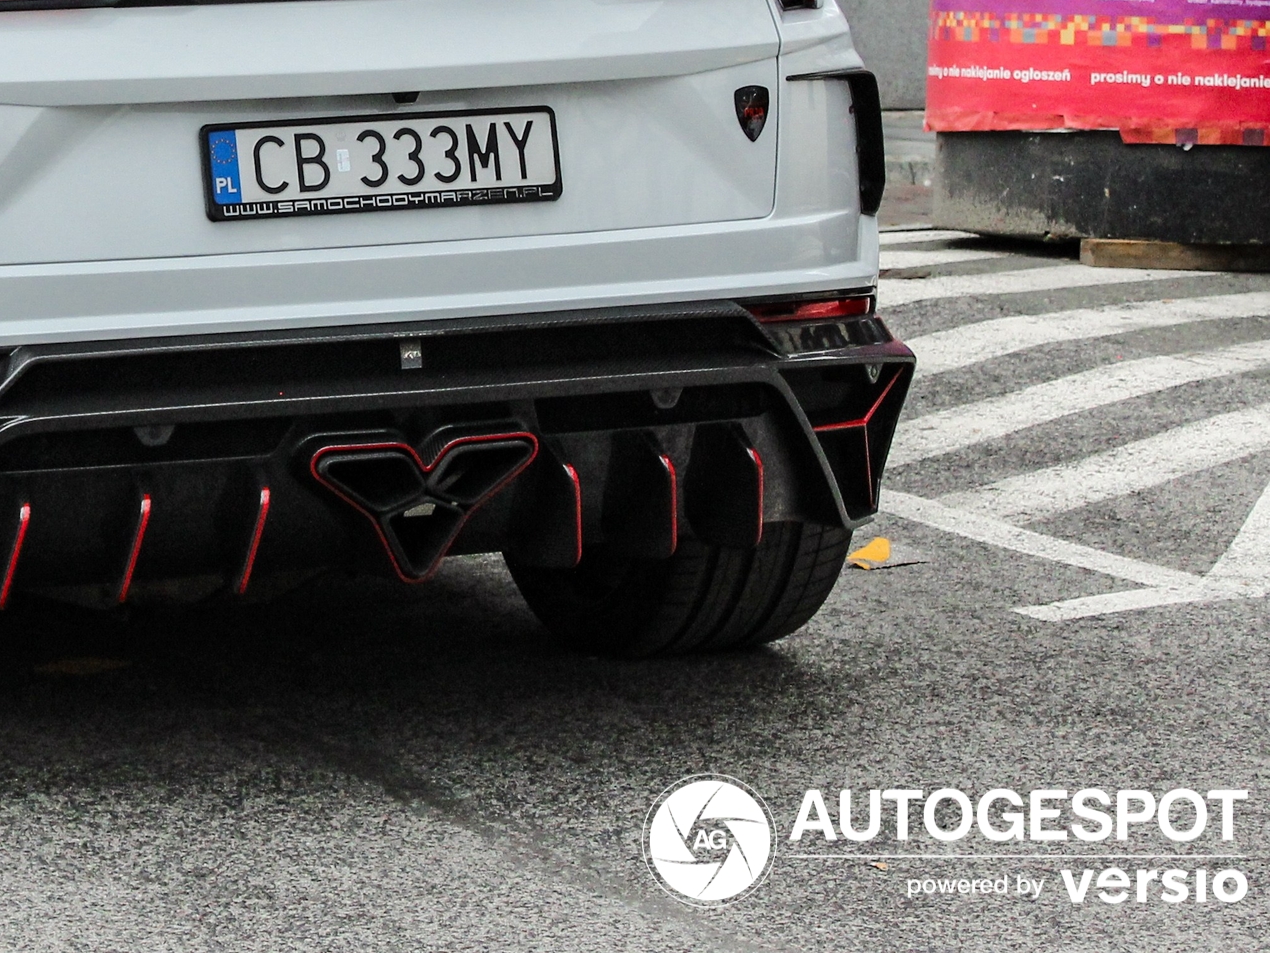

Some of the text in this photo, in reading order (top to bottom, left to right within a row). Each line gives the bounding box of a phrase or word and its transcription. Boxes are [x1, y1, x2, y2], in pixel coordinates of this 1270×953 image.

[961, 65, 1011, 81] naklejanie
[1013, 67, 1071, 83] ogłoszeń
[1090, 70, 1270, 90] prosimy o nie naklejanie
[252, 120, 534, 194] CB 333MY
[216, 177, 237, 194] PL
